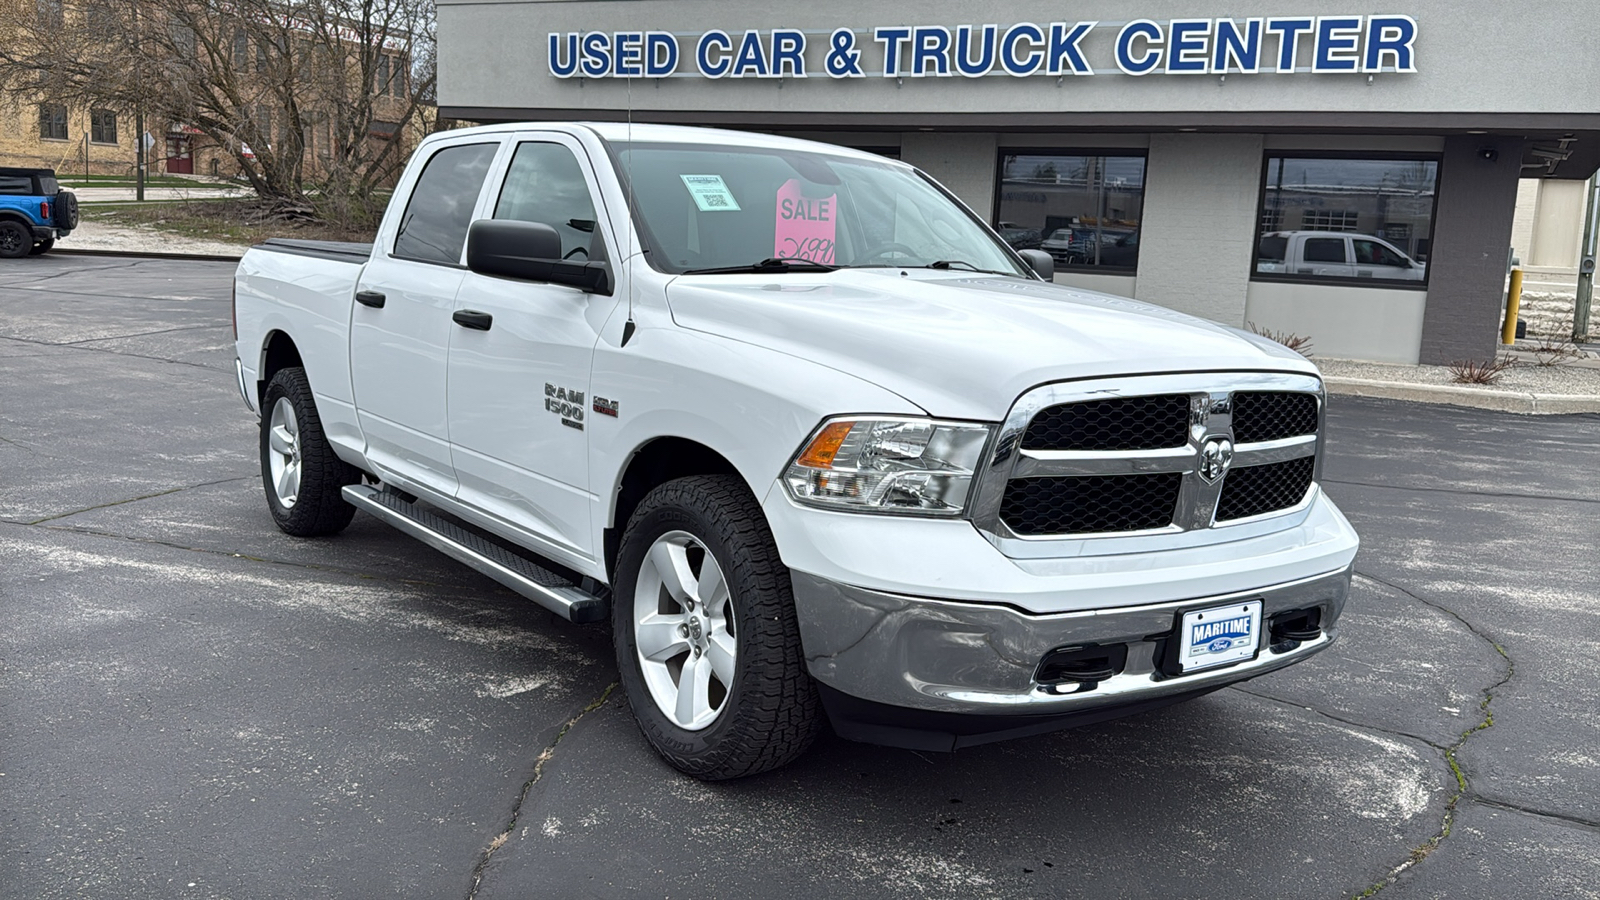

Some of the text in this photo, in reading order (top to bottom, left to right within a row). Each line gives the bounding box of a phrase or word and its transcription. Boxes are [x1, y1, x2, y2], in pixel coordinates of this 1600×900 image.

[548, 14, 1419, 79] USED CAR & TRUCK CENTER
[780, 198, 830, 221] SALE
[544, 382, 585, 406] RAM
[544, 397, 584, 422] 1500
[1192, 616, 1250, 645] MARITIME
[1210, 640, 1230, 651] Ford
